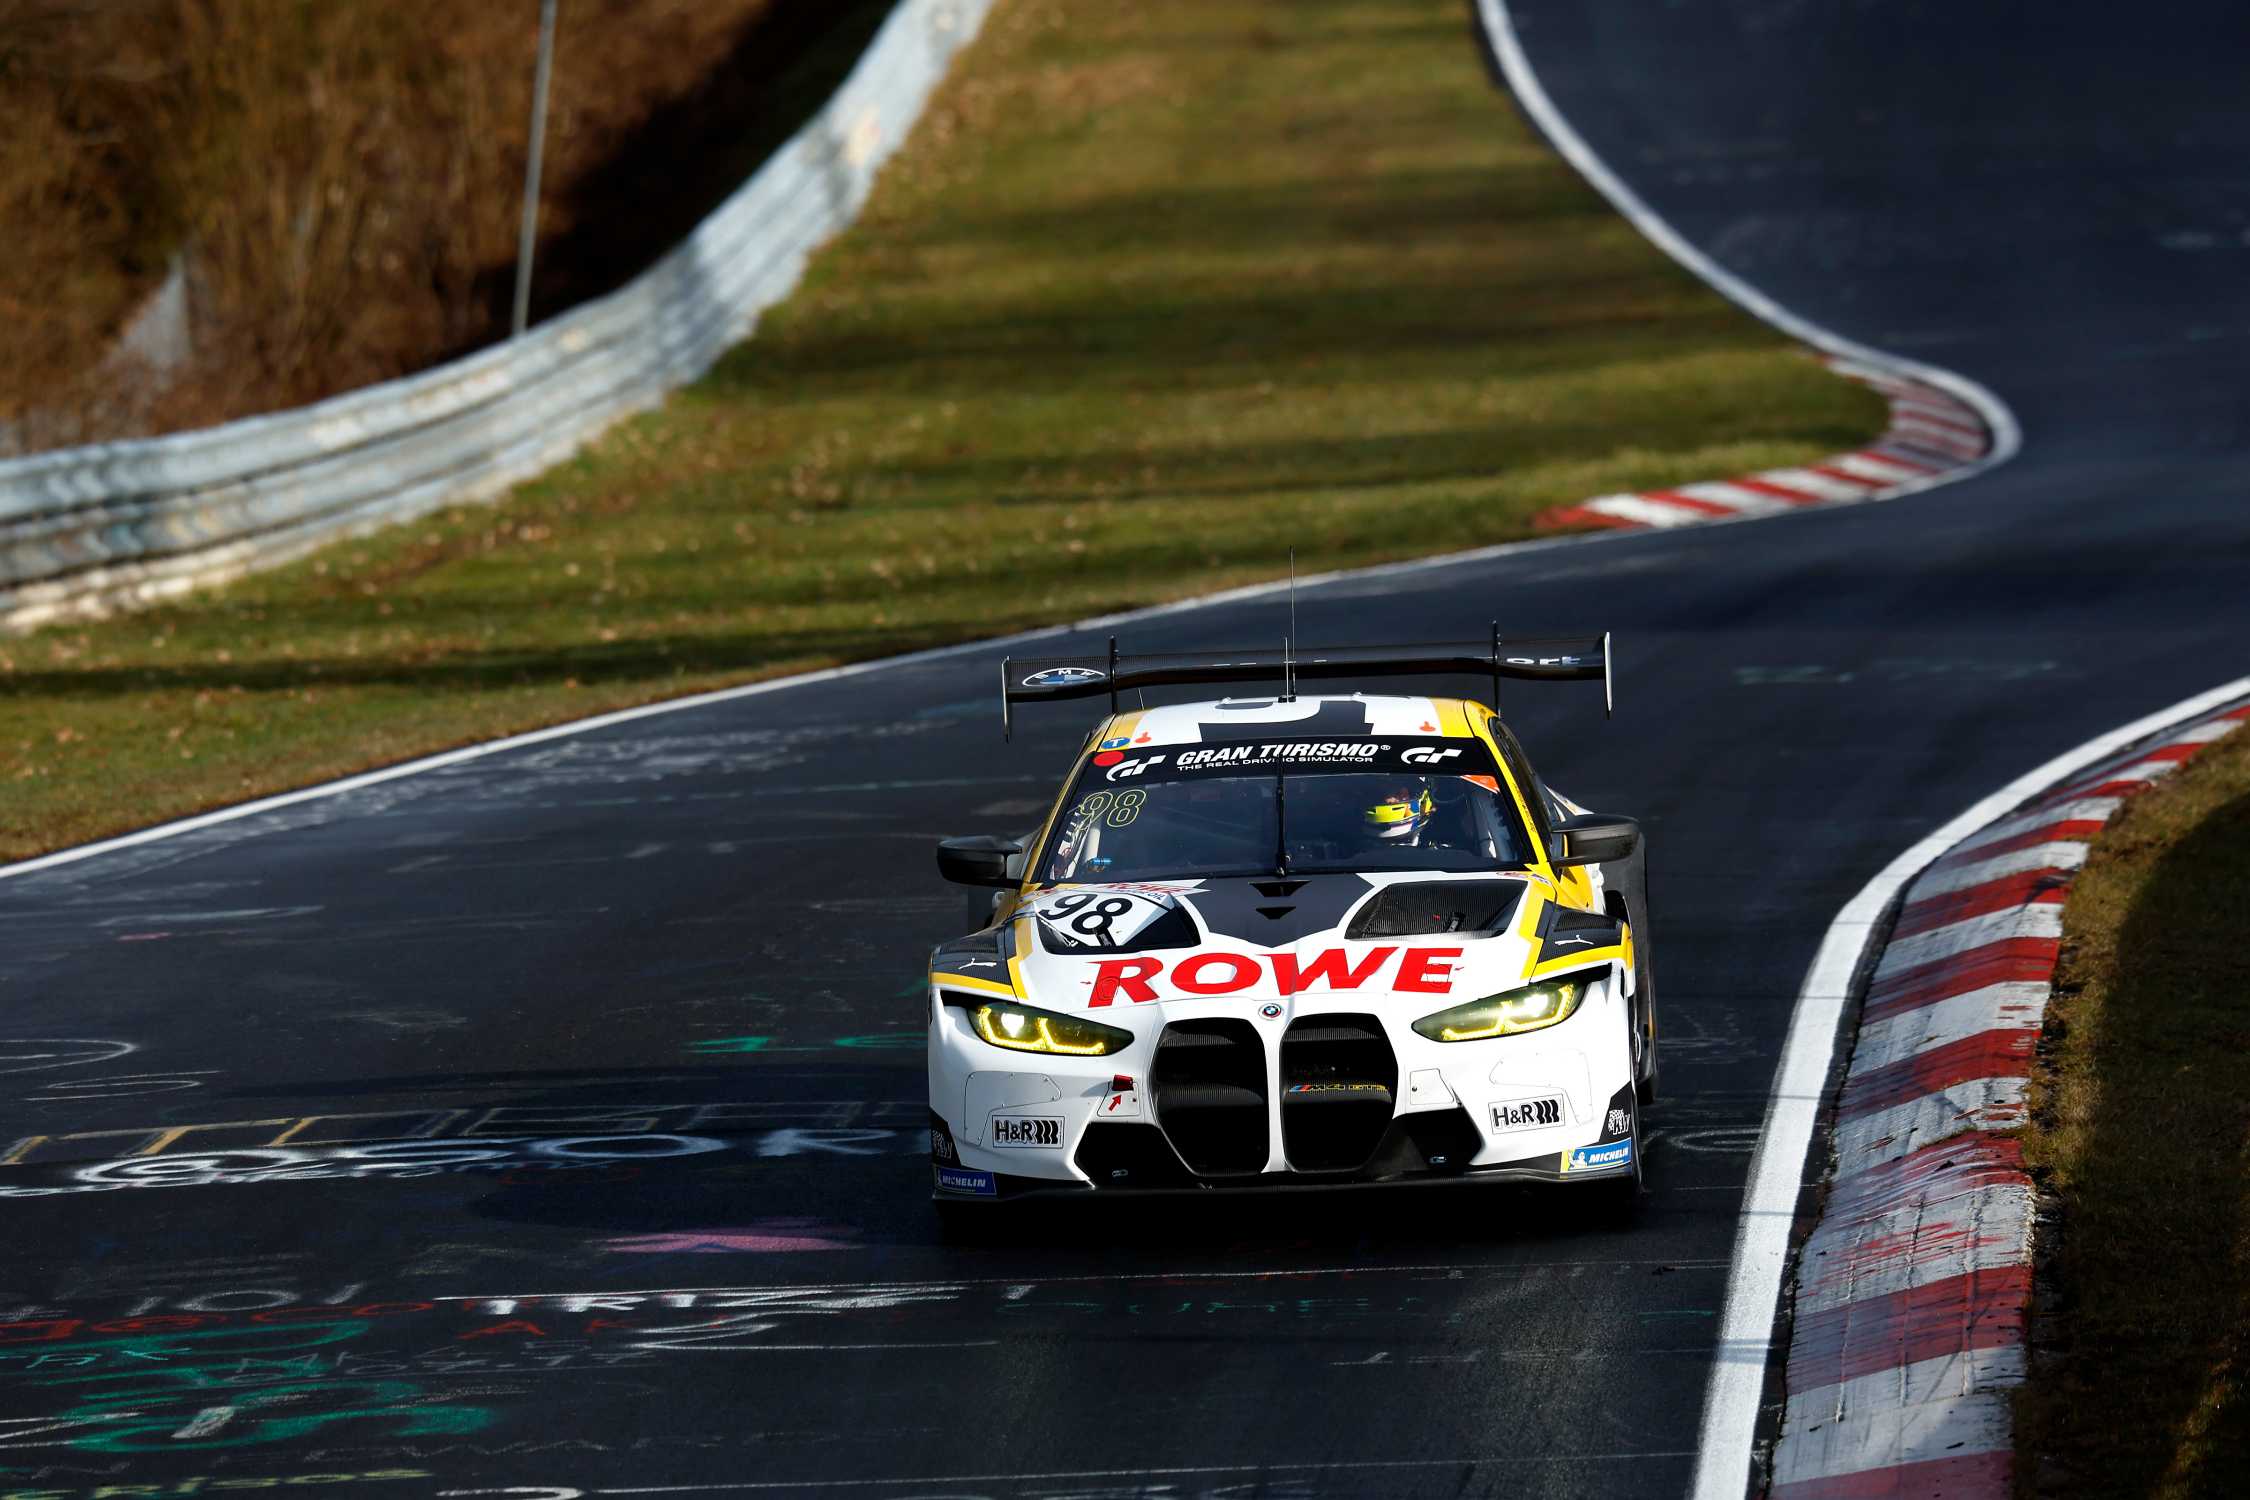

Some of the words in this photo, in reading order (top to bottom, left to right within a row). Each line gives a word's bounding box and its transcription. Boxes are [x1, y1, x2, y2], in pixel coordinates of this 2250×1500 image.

[1176, 744, 1254, 766] GRAN
[1176, 763, 1203, 772] THE
[1205, 760, 1240, 769] REAL
[1298, 756, 1374, 764] SIMULATOR
[1074, 788, 1147, 831] 98
[1037, 893, 1133, 936] 98
[1085, 945, 1465, 1009] ROWE
[1493, 1103, 1535, 1127] H&R
[994, 1119, 1034, 1142] H&R
[1588, 1147, 1630, 1164] MICHELIN
[942, 1174, 987, 1188] MICHELIN
